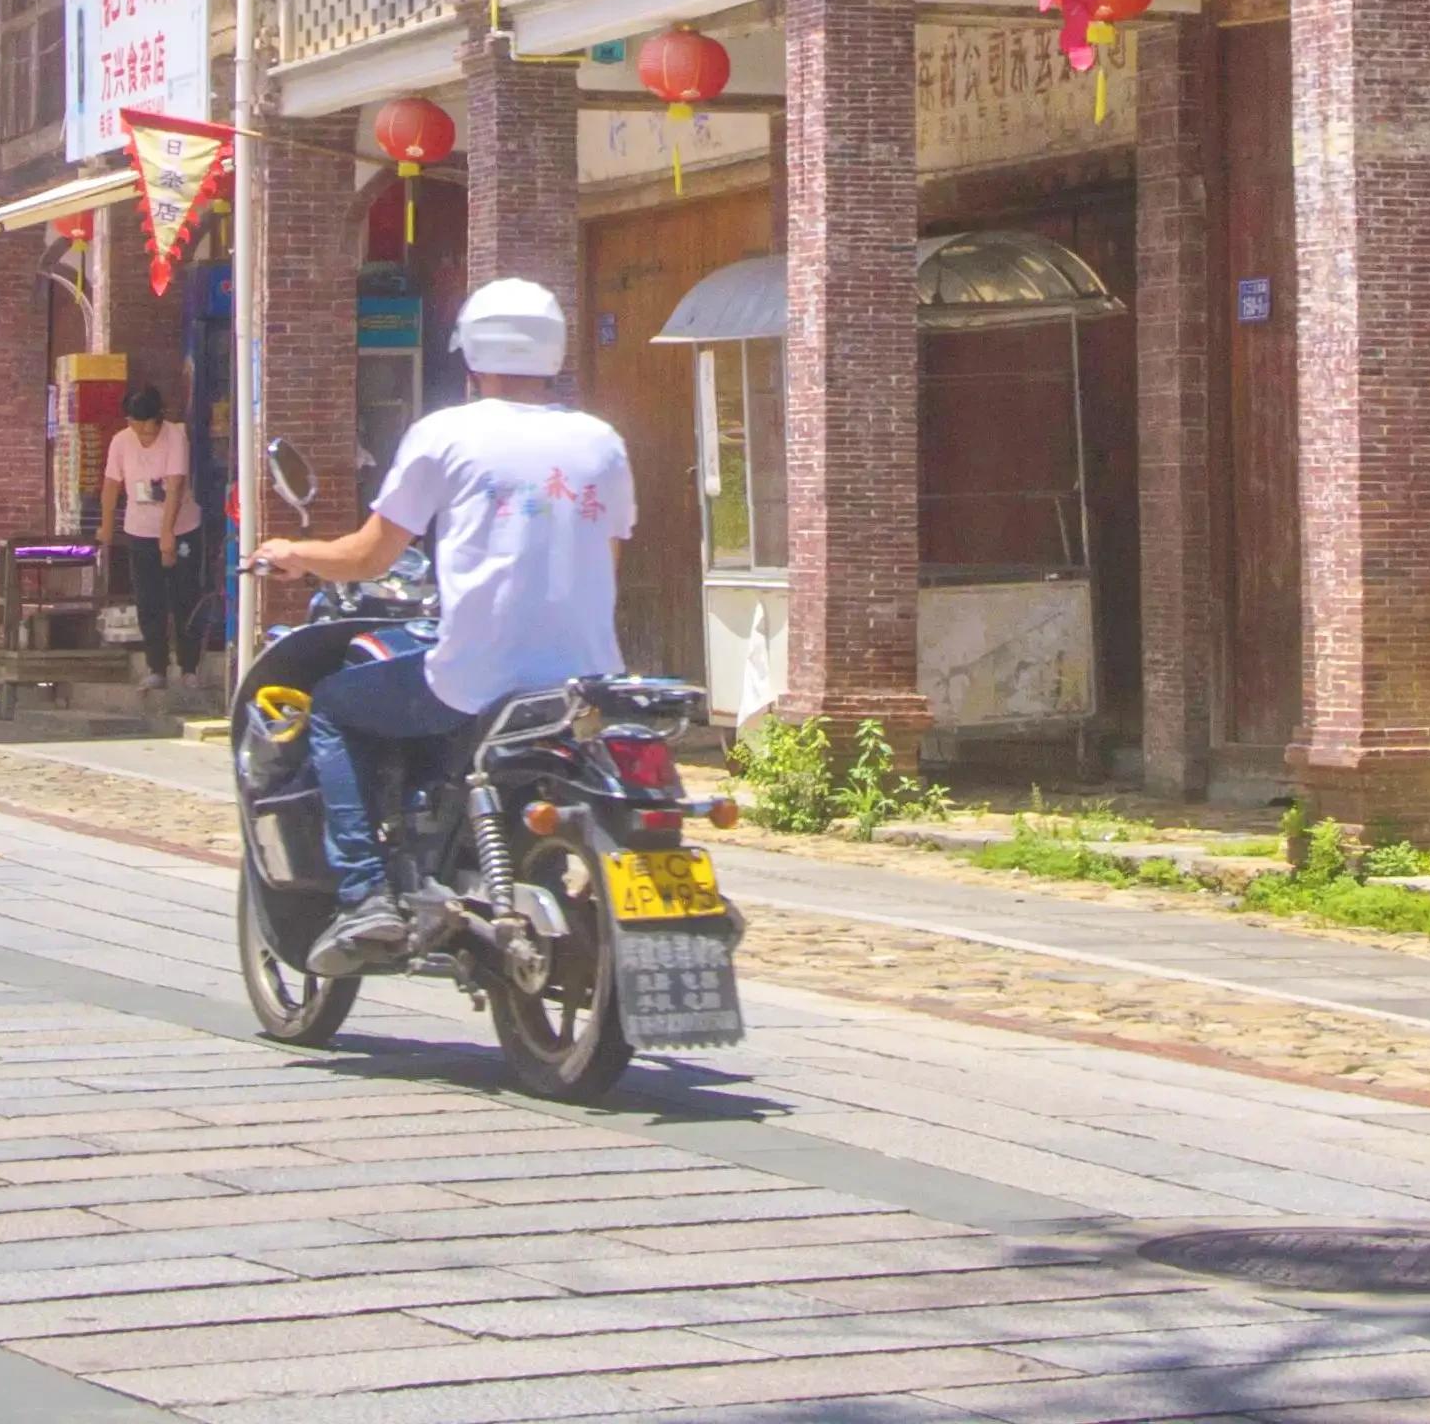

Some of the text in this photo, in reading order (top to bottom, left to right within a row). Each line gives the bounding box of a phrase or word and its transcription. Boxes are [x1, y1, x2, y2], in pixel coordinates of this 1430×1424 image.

[101, 30, 165, 101] 万兴食杂店
[155, 139, 184, 222] 日杂店
